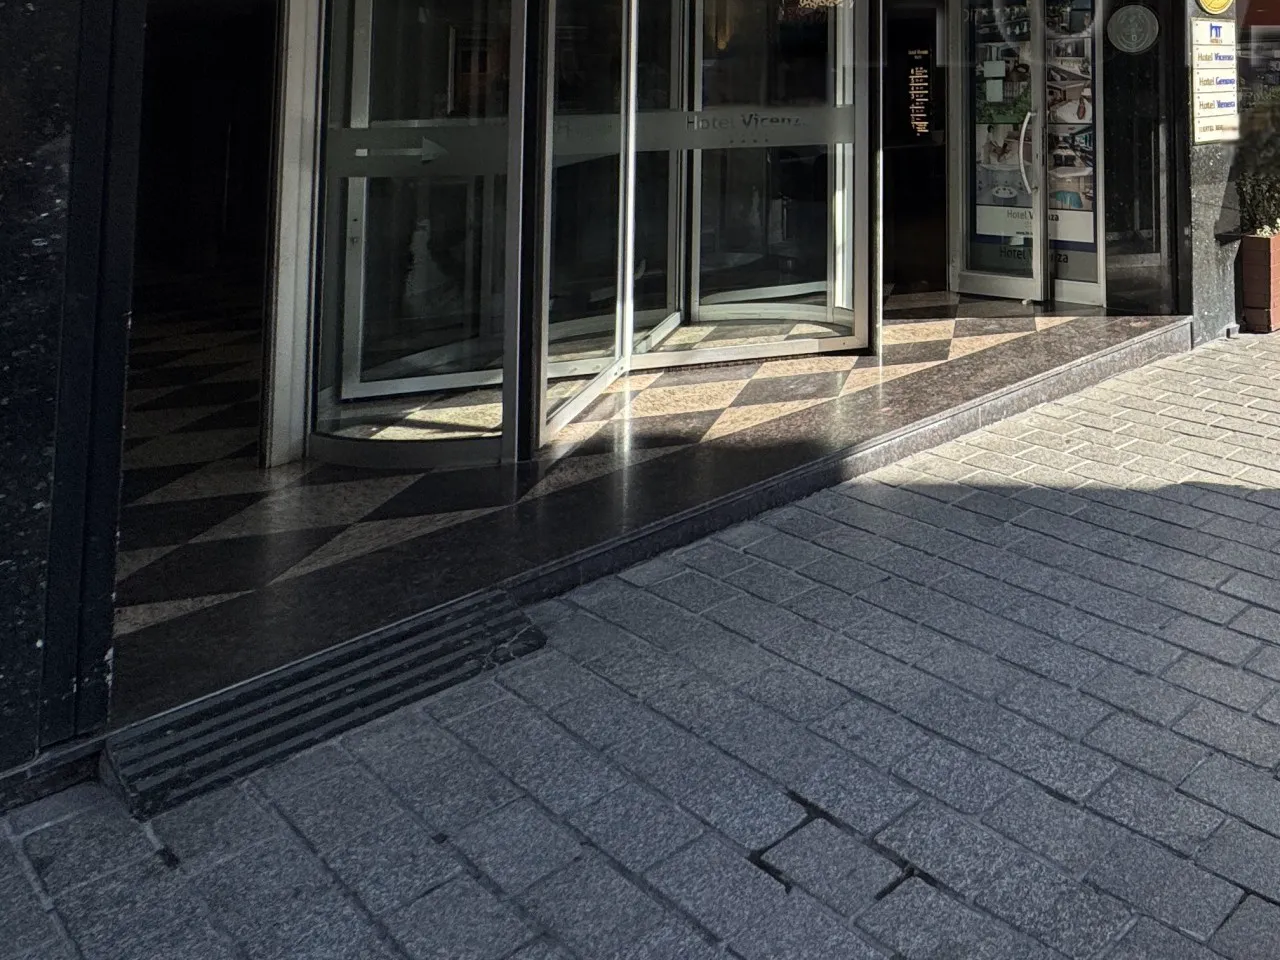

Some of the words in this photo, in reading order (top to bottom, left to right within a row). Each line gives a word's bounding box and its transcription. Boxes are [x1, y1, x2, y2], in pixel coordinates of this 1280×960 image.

[1197, 52, 1213, 62] Hotel
[1199, 76, 1215, 86] Hotel
[1199, 100, 1215, 110] Hotel
[1006, 209, 1028, 221] Hotel
[1001, 245, 1026, 260] Hotel
